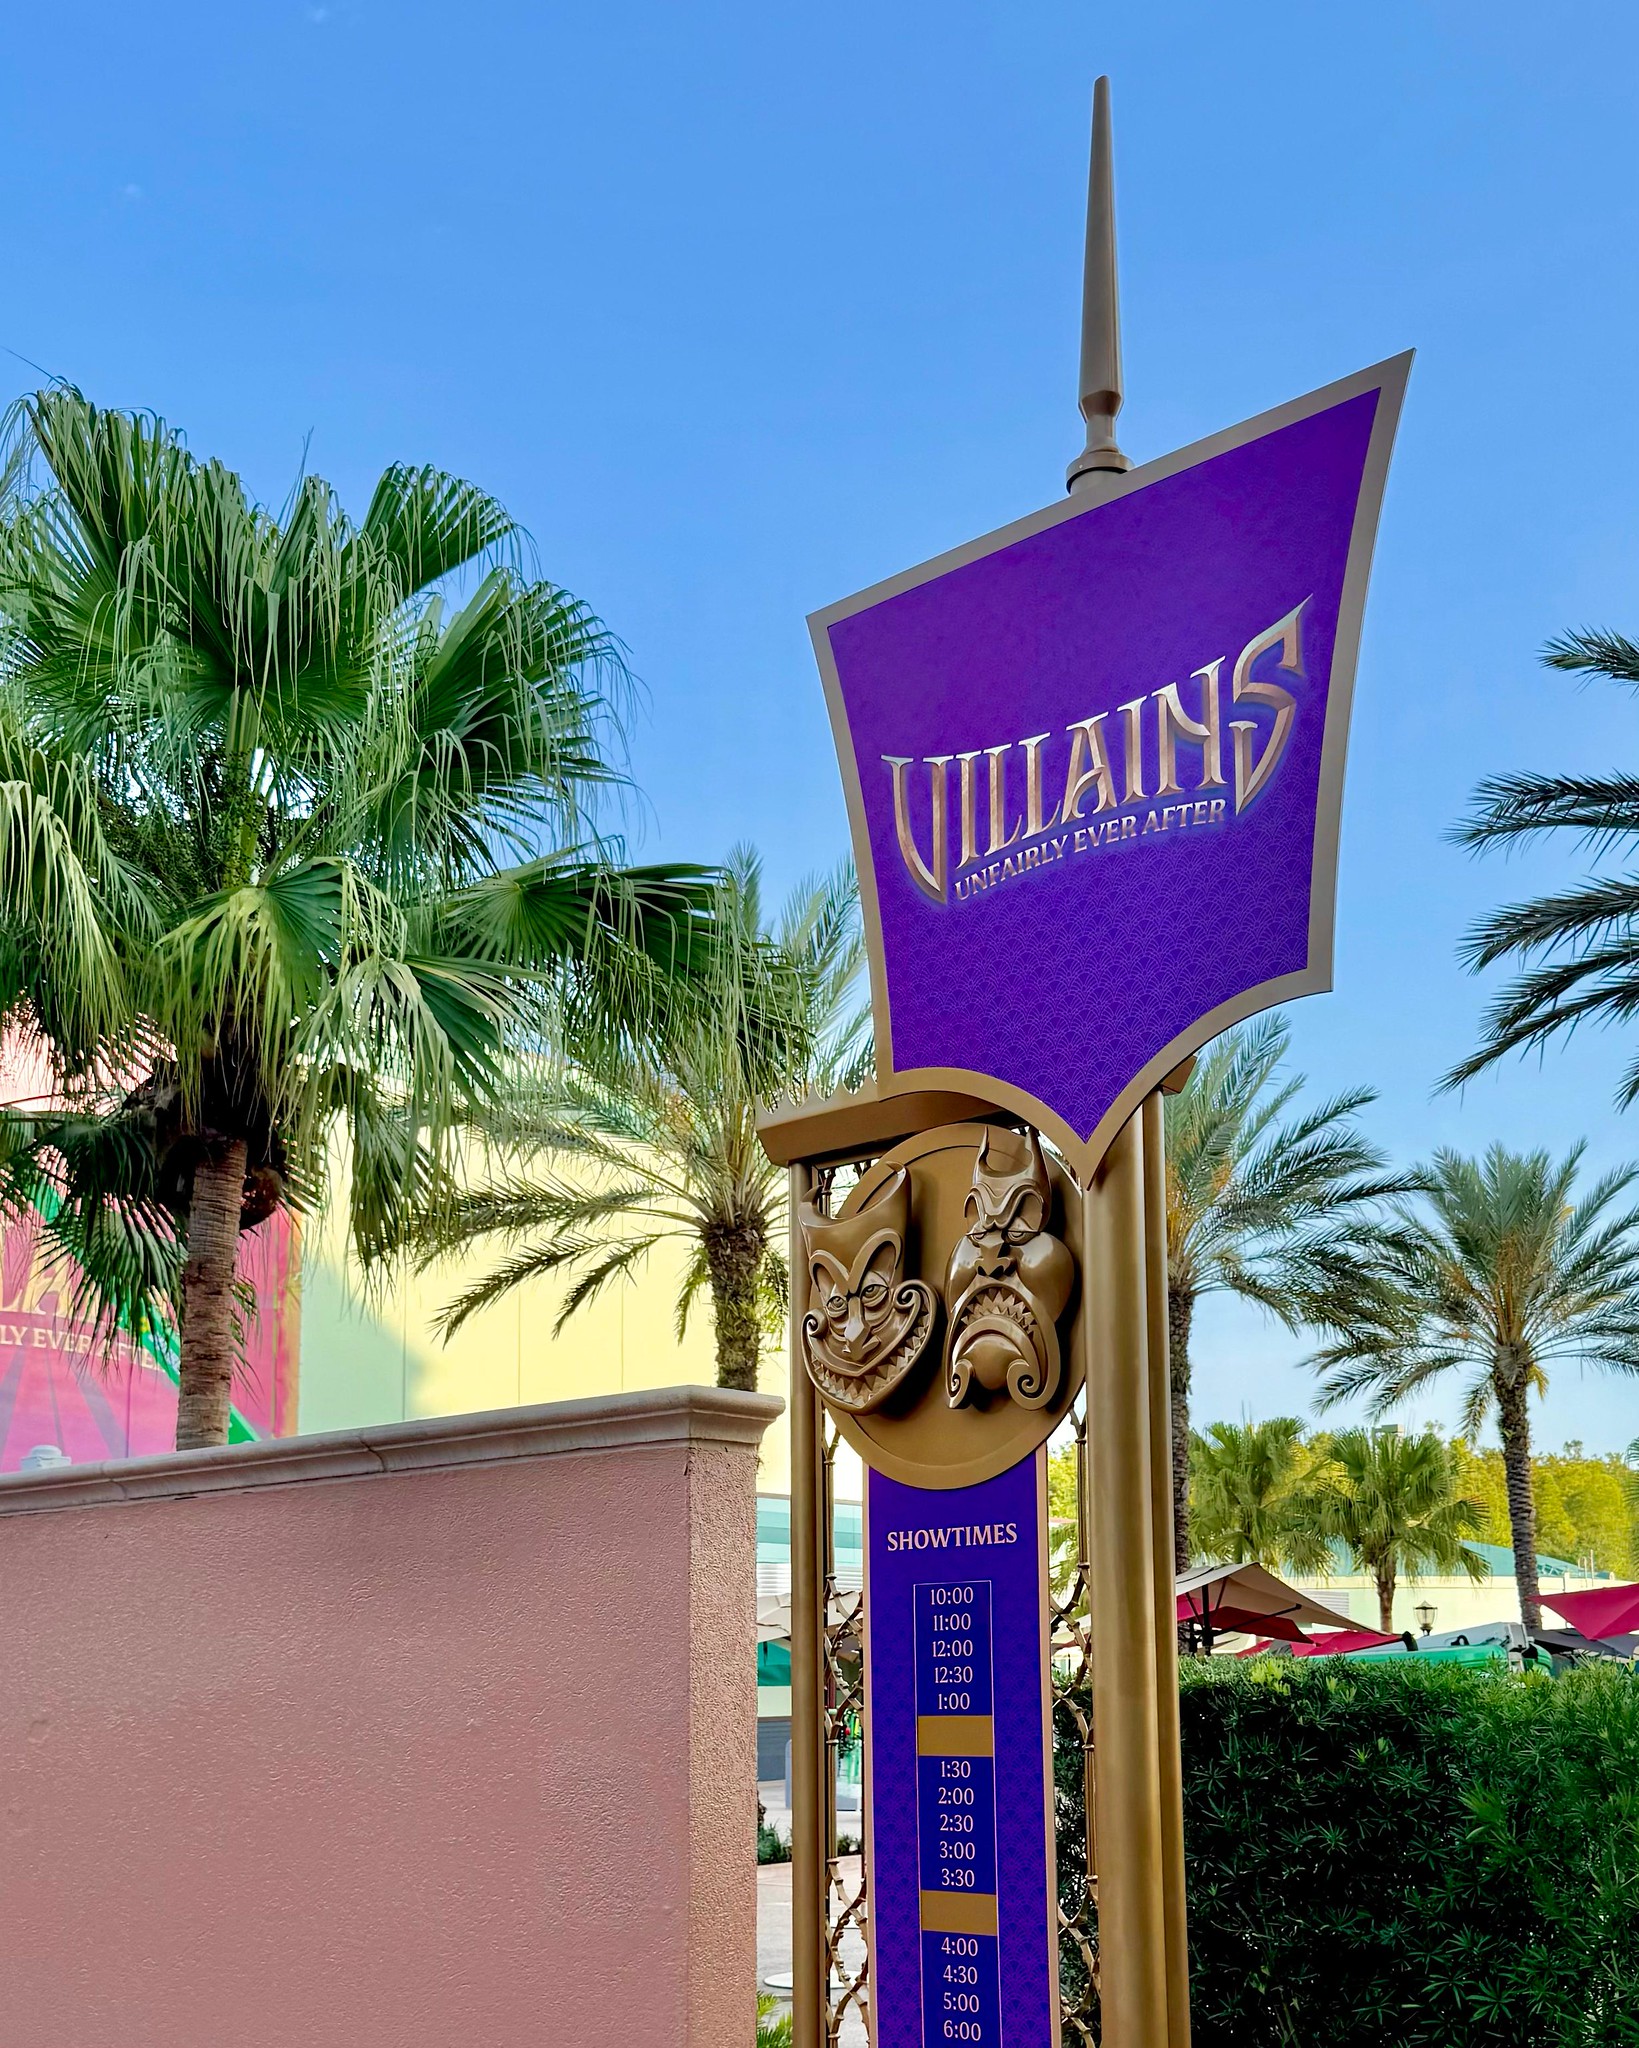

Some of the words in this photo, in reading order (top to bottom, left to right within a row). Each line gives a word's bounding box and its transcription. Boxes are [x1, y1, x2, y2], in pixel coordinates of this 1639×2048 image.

[881, 593, 1314, 904] VILLAINS
[954, 834, 1068, 901] UNFAIRLY
[1073, 814, 1137, 853] EVER
[1141, 798, 1227, 835] AFTER
[32, 1327, 94, 1355] EVER
[888, 1523, 1017, 1551] SHOWTIMES
[930, 1587, 974, 1605] 10:00
[933, 1613, 971, 1631] 11:00
[932, 1640, 973, 1657] 12:00
[935, 1666, 973, 1683] 12:30
[938, 1692, 970, 1710] 1:00
[941, 1761, 971, 1778] 1:30
[938, 1787, 974, 1805] 2:00
[940, 1814, 973, 1832] 2:30
[939, 1841, 975, 1859] 3:00
[941, 1869, 975, 1887] 3:30
[941, 1937, 978, 1956] 4:00
[943, 1965, 978, 1984] 4:30
[943, 1993, 980, 2012] 5:00
[943, 2020, 981, 2041] 6:00
